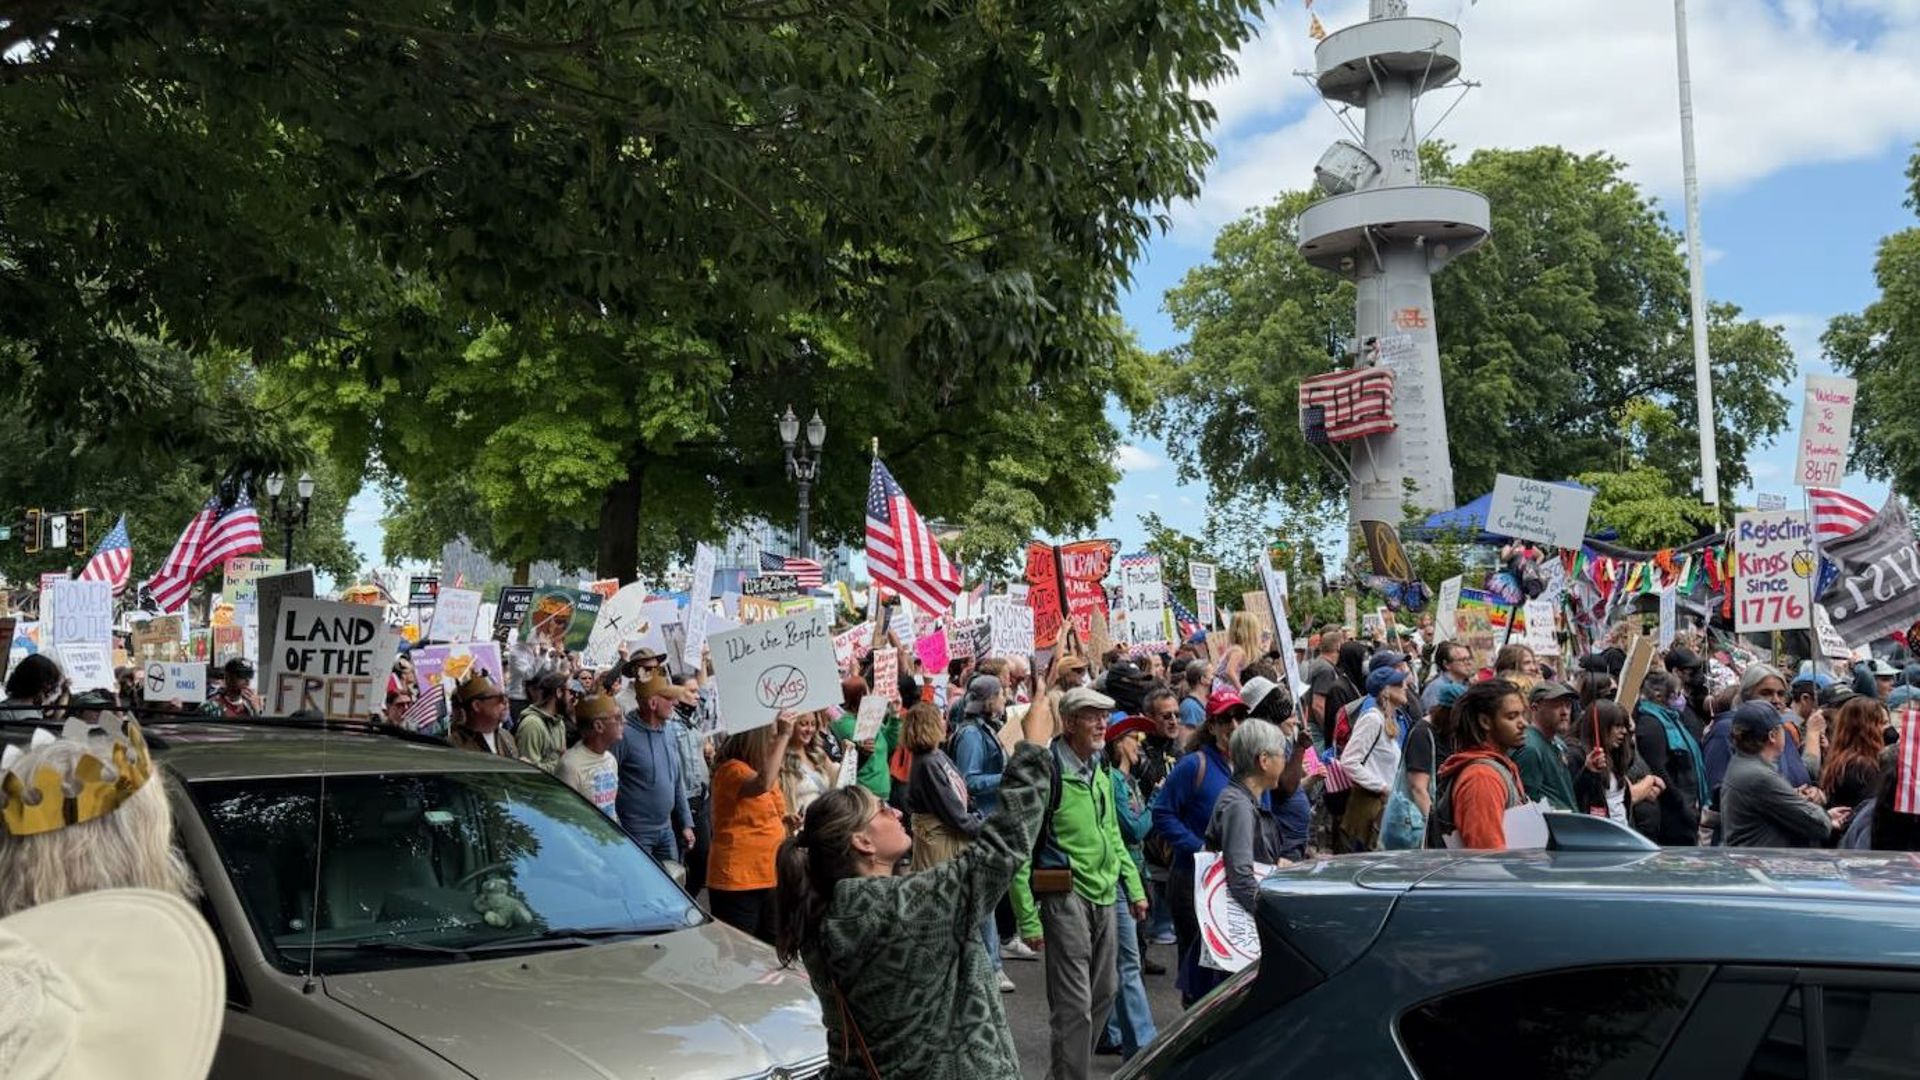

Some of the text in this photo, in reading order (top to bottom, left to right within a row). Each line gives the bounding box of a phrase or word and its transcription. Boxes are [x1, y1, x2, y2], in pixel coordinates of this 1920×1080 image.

[1823, 407, 1834, 420] To
[1805, 459, 1837, 482] 8647
[1519, 479, 1552, 500] Unity
[1513, 495, 1551, 513] with the
[1514, 505, 1544, 526] Trans
[1498, 515, 1557, 543] Community
[1739, 516, 1812, 548] Rejecting
[232, 560, 271, 574] be fair
[1738, 551, 1789, 578] Kings
[226, 575, 240, 586] be
[57, 583, 108, 613] POWER
[577, 603, 599, 612] KINGS
[580, 594, 591, 602] NO
[1741, 594, 1804, 625] 1776
[389, 605, 411, 618] NO
[744, 603, 762, 622] NO
[994, 605, 1031, 630] MOMS
[57, 615, 79, 641] TO
[284, 610, 376, 646] LAND
[725, 617, 826, 662] We the People
[285, 647, 374, 677] OF THE
[273, 671, 374, 719] FREE
[762, 677, 805, 704] Kings
